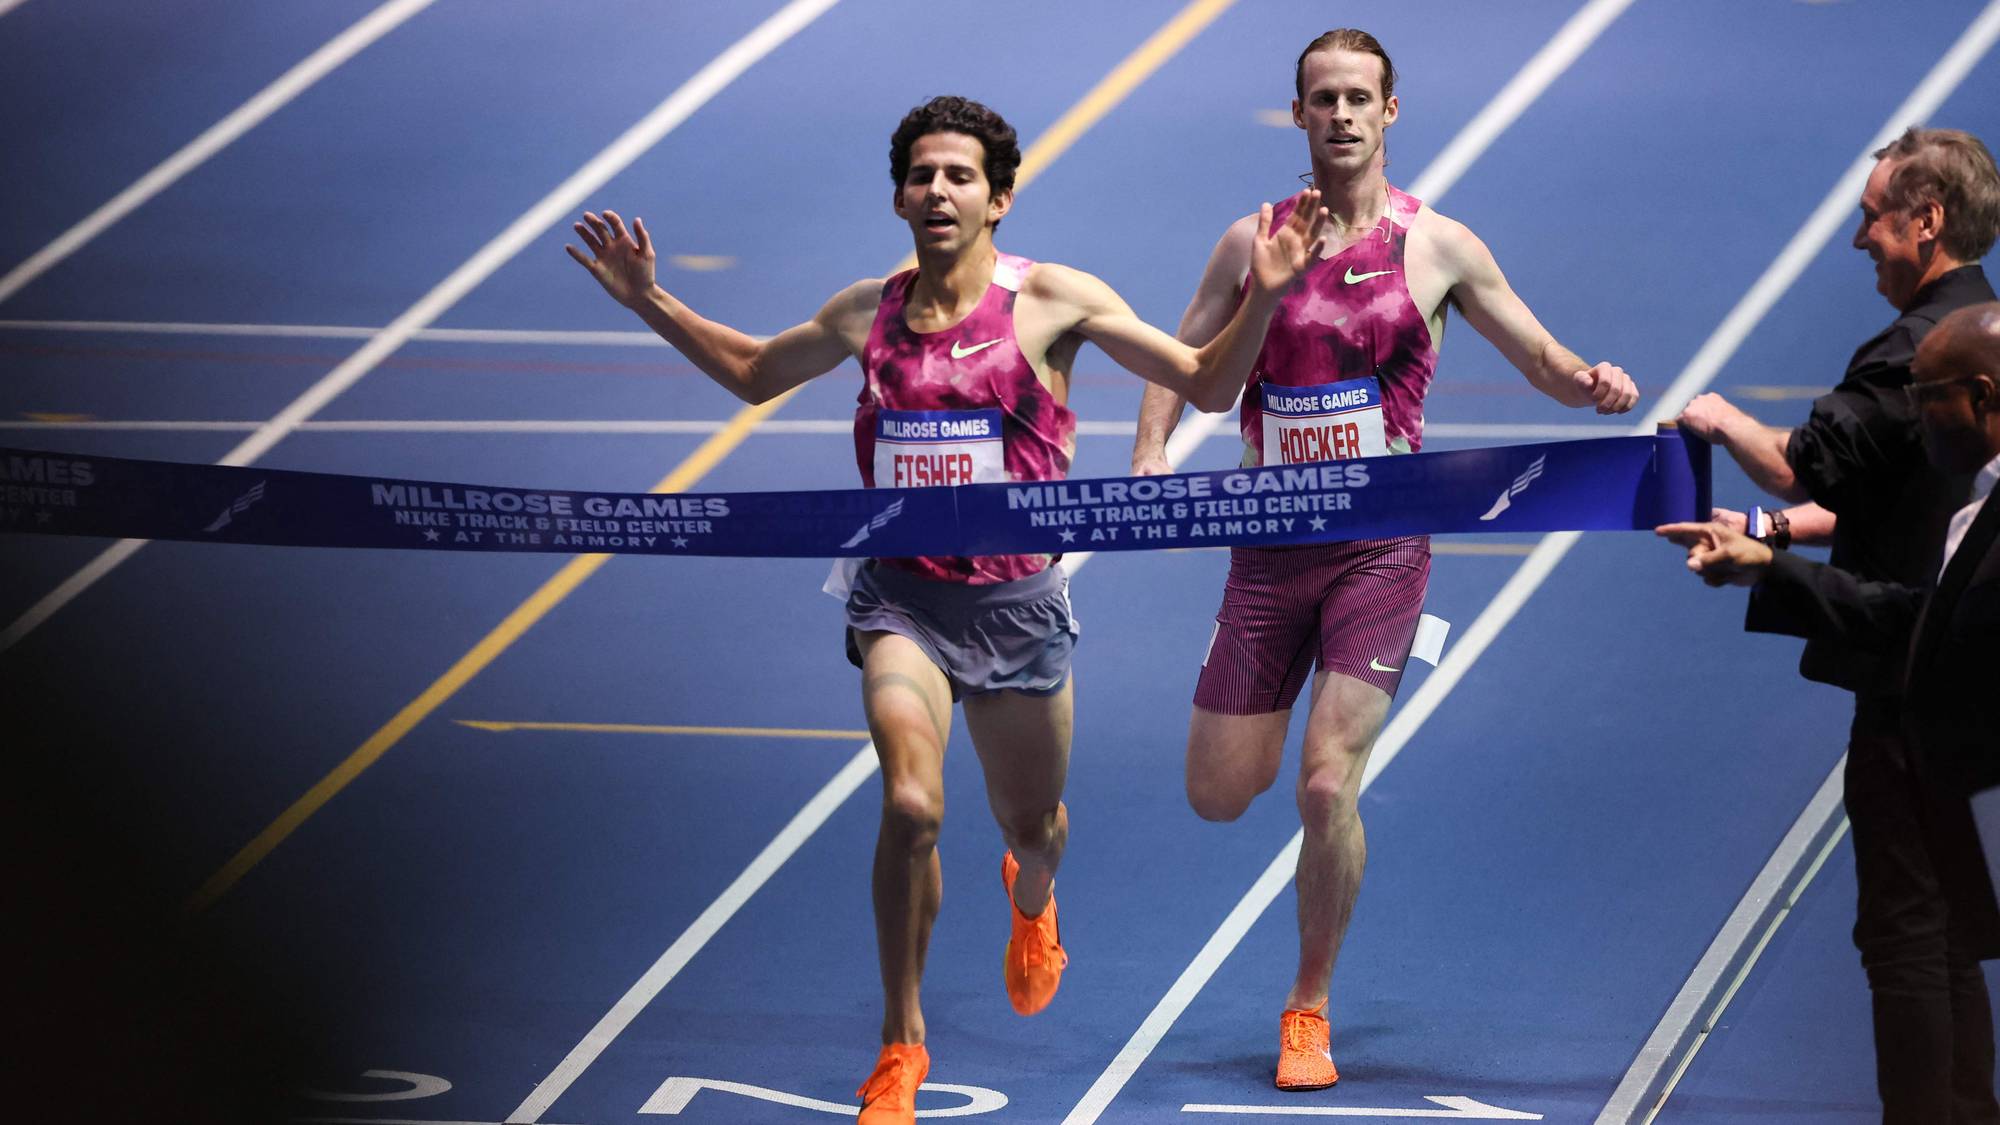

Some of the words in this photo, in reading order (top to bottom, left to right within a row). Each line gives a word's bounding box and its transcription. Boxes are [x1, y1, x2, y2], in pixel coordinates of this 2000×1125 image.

[1267, 395, 1319, 412] MILLROSE
[1321, 388, 1368, 410] GAMES
[883, 419, 938, 438] MILLROSE
[940, 418, 990, 437] GAMES
[1279, 422, 1361, 464] HOCKER
[0, 456, 95, 486] MES
[894, 453, 973, 489] FISHER
[371, 483, 573, 516] MILLROSE
[583, 497, 731, 519] GAMES
[1007, 476, 1212, 510] MILLROSE
[1222, 463, 1370, 495] GAMES
[395, 510, 450, 527] NIKE
[455, 512, 530, 531] TRACK
[535, 516, 550, 532] &
[556, 517, 620, 534] FIELD
[626, 520, 712, 534] CENTER
[1030, 511, 1087, 527] NIKE
[1091, 503, 1166, 523] TRACK
[1172, 502, 1189, 519] &
[1194, 498, 1258, 517] FIELD
[1265, 492, 1352, 514] CENTER
[454, 531, 482, 543] AT
[494, 532, 541, 545] THE
[553, 533, 657, 548] ARMORY
[1090, 527, 1118, 542] AT
[1132, 525, 1178, 540] THE
[1189, 518, 1296, 538] ARMORY
